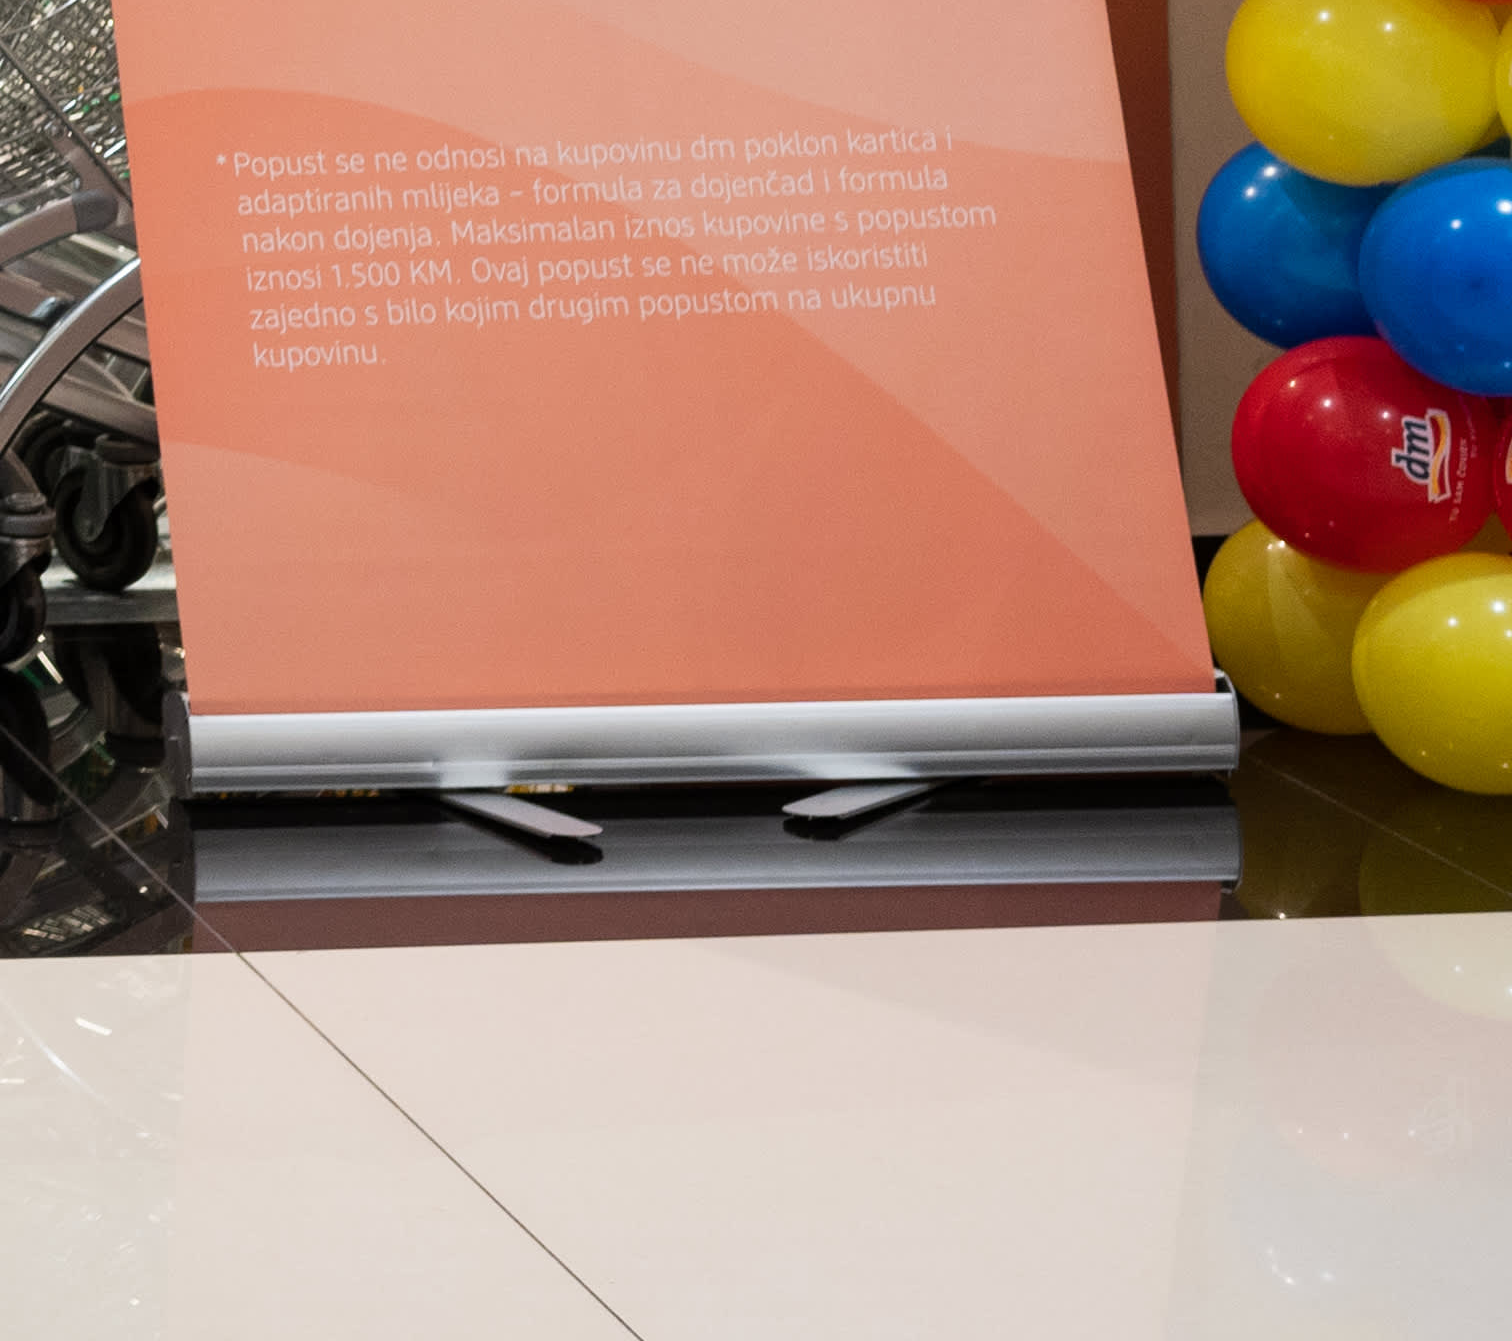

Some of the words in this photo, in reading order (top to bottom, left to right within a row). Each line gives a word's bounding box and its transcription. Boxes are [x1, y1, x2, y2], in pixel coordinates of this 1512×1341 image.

[335, 152, 365, 174] se
[374, 150, 408, 173] ne
[416, 141, 506, 171] odnosi
[515, 145, 548, 166] na
[556, 136, 682, 170] kupovinu
[690, 134, 735, 161] dm
[744, 130, 838, 164] poklon
[846, 128, 936, 154] kartica
[237, 184, 393, 218] adaptiranih
[402, 181, 500, 214] mlijeka
[532, 175, 643, 205] formula
[652, 178, 682, 200] za
[690, 168, 815, 204] dojenčad
[838, 164, 949, 193] formula
[242, 226, 325, 253] nakon
[333, 222, 440, 254] dojenja.
[450, 214, 615, 245] Maksimalan
[625, 216, 695, 239] iznos
[702, 210, 825, 241] kupovine
[857, 204, 997, 236] popustom
[246, 264, 322, 292] iznosi
[331, 261, 401, 289] 1.500
[409, 259, 461, 285] KM.
[471, 256, 529, 288] Ovaj
[537, 253, 634, 286] popust
[641, 255, 672, 277] se
[680, 254, 713, 275] ne
[722, 246, 798, 274] može
[807, 241, 928, 271] iskoristiti
[249, 301, 356, 335] zajedno
[386, 297, 437, 326] bilo
[444, 296, 520, 330] kojim
[528, 292, 630, 325] drugim
[638, 289, 779, 322] popustom
[788, 288, 822, 311] na
[831, 282, 936, 313] ukupnu
[252, 340, 387, 373] kupovinu.
[1394, 419, 1431, 481] dm
